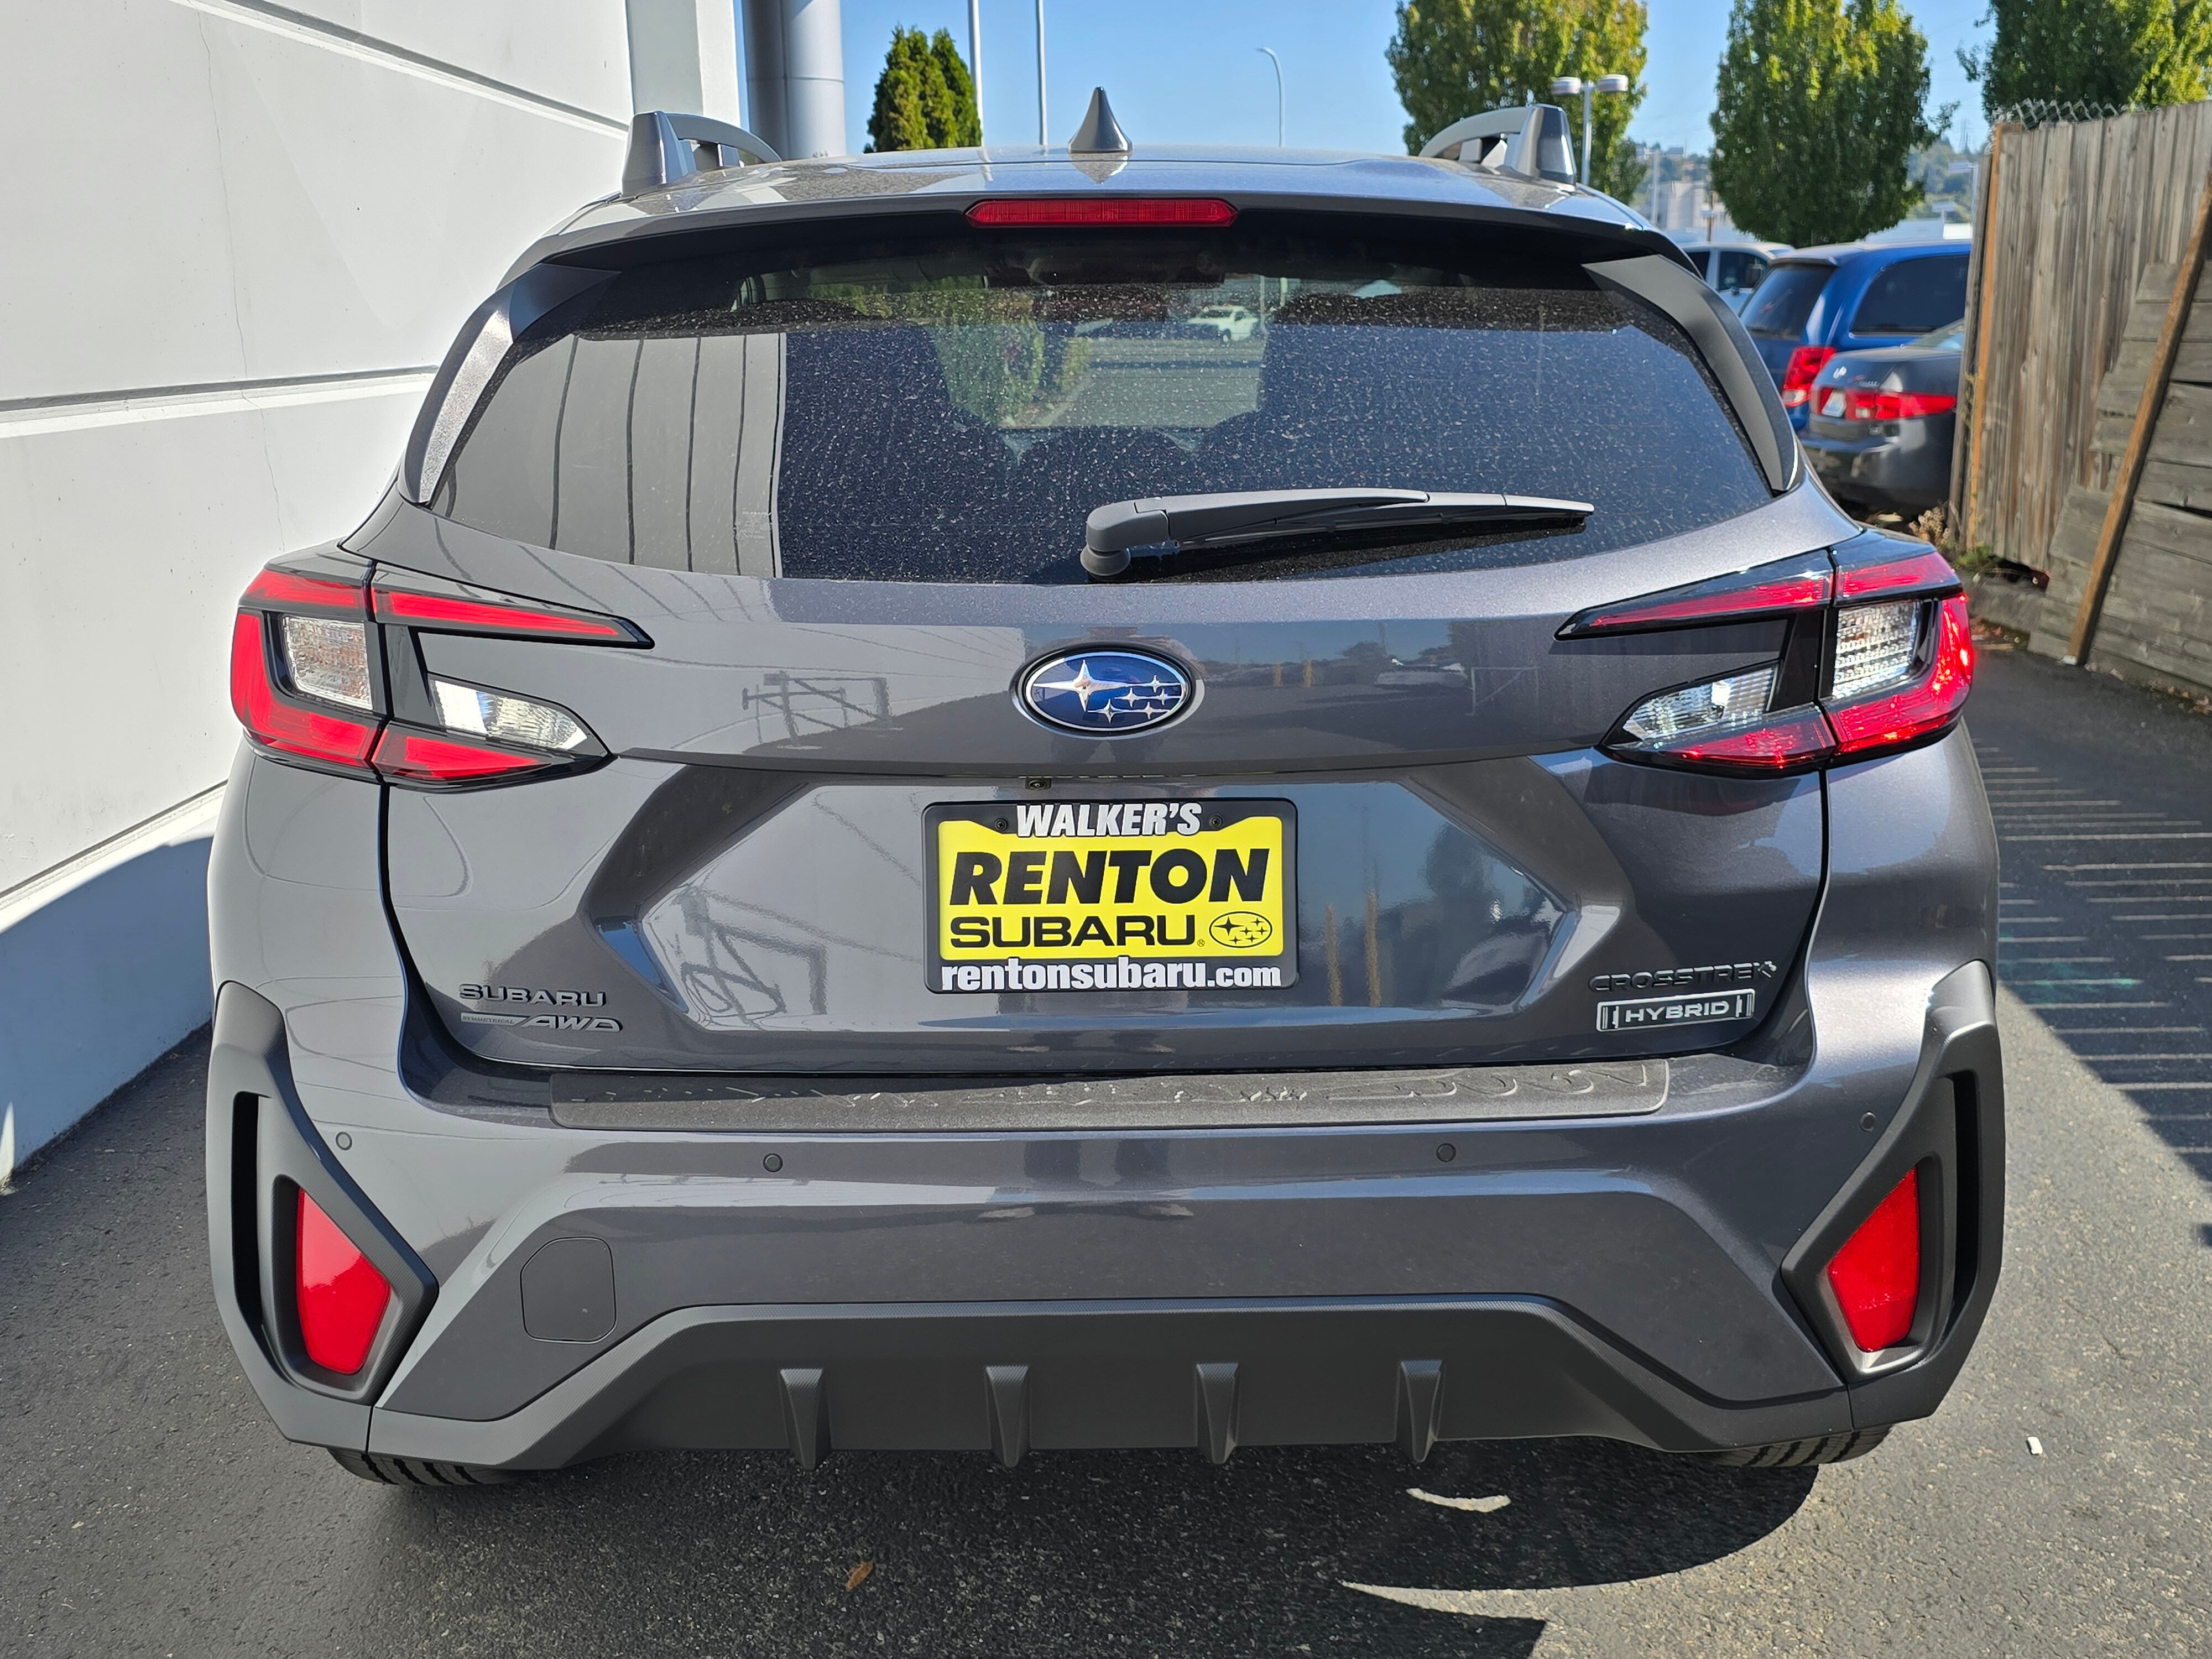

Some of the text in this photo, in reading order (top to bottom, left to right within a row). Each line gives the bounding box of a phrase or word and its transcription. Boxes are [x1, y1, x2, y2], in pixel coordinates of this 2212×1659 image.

[1017, 803, 1202, 837] WALKER'S
[949, 848, 1270, 906] RENTON
[950, 914, 1196, 948] SUBARU
[941, 956, 1281, 991] rentonsubaru.com
[1588, 961, 1777, 993] CROSSTREK
[458, 983, 607, 1008] SUBARU
[1625, 1000, 1730, 1022] HYBRID
[519, 1014, 623, 1032] AWD
